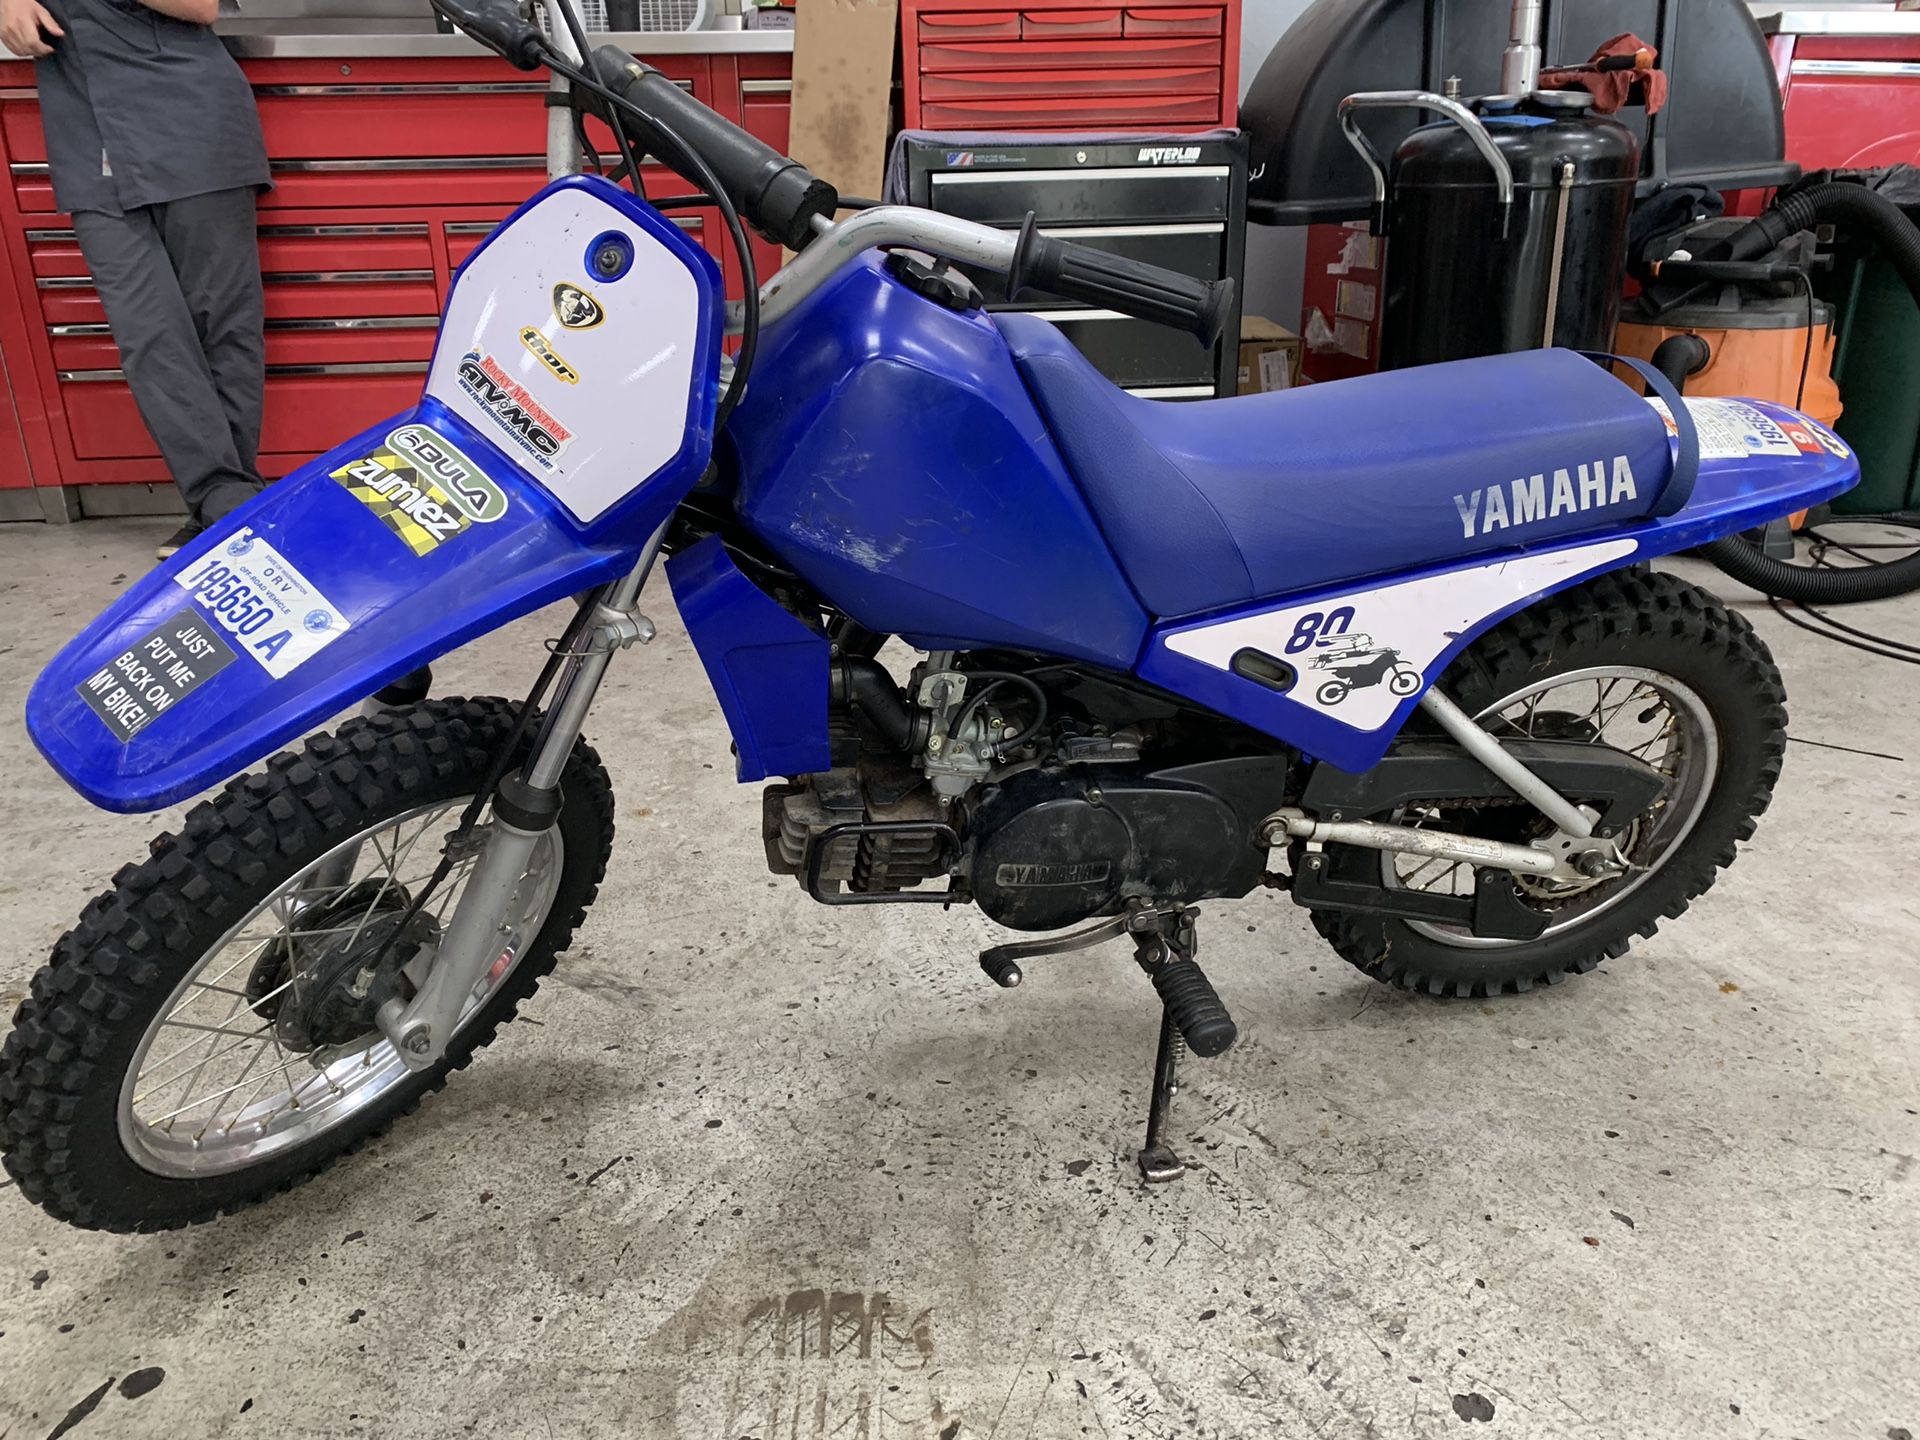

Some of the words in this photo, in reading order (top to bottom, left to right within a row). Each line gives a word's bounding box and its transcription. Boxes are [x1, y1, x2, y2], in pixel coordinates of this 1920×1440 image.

[523, 330, 575, 380] thor
[458, 378, 554, 470] www.rockymountainatvmc.com
[480, 355, 514, 391] ROCKY
[508, 383, 571, 443] MOUNTAIN
[413, 441, 489, 513] BULA
[1453, 455, 1637, 538] YAMAHA
[188, 560, 274, 636] 195650
[254, 629, 293, 662] A
[240, 566, 267, 591] OFF-ROAD
[266, 590, 291, 615] VEHICLE
[176, 626, 216, 660] JUST
[1284, 606, 1356, 655] 80
[87, 668, 118, 695] MY
[115, 651, 155, 692] BACK
[145, 685, 174, 711] ON
[144, 636, 177, 665] PUT
[166, 660, 196, 688] ME
[1015, 864, 1094, 884] YAMAHA
